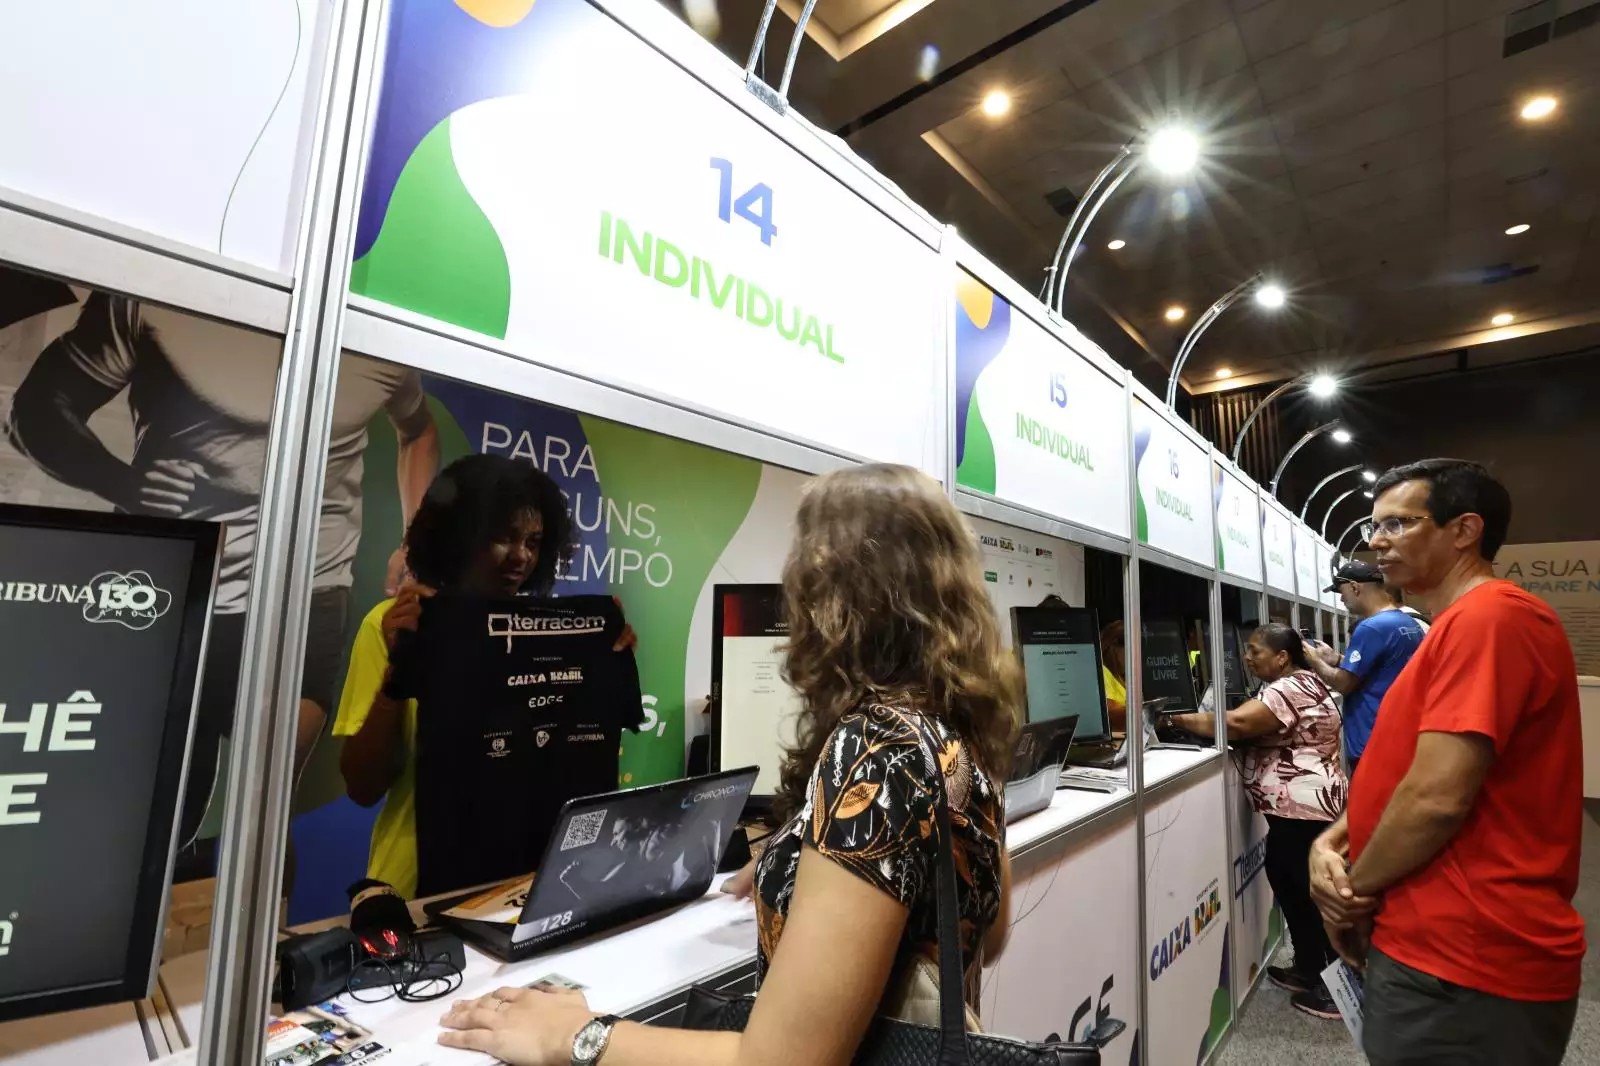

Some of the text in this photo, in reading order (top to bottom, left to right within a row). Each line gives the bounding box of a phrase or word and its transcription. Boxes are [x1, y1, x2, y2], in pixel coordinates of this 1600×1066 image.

[710, 157, 777, 247] 14
[598, 210, 845, 364] INDIVIDUAL
[1049, 372, 1067, 408] 15
[481, 422, 600, 483] PARA
[1016, 412, 1094, 471] INDIVIDUAL
[1156, 487, 1194, 521] INDIVIDUAL
[1530, 560, 1590, 577] SUA
[0, 581, 157, 611] IBUNA 130
[507, 673, 547, 687] CAIXA
[540, 910, 573, 932] 128
[1150, 915, 1191, 981] CAIXA
